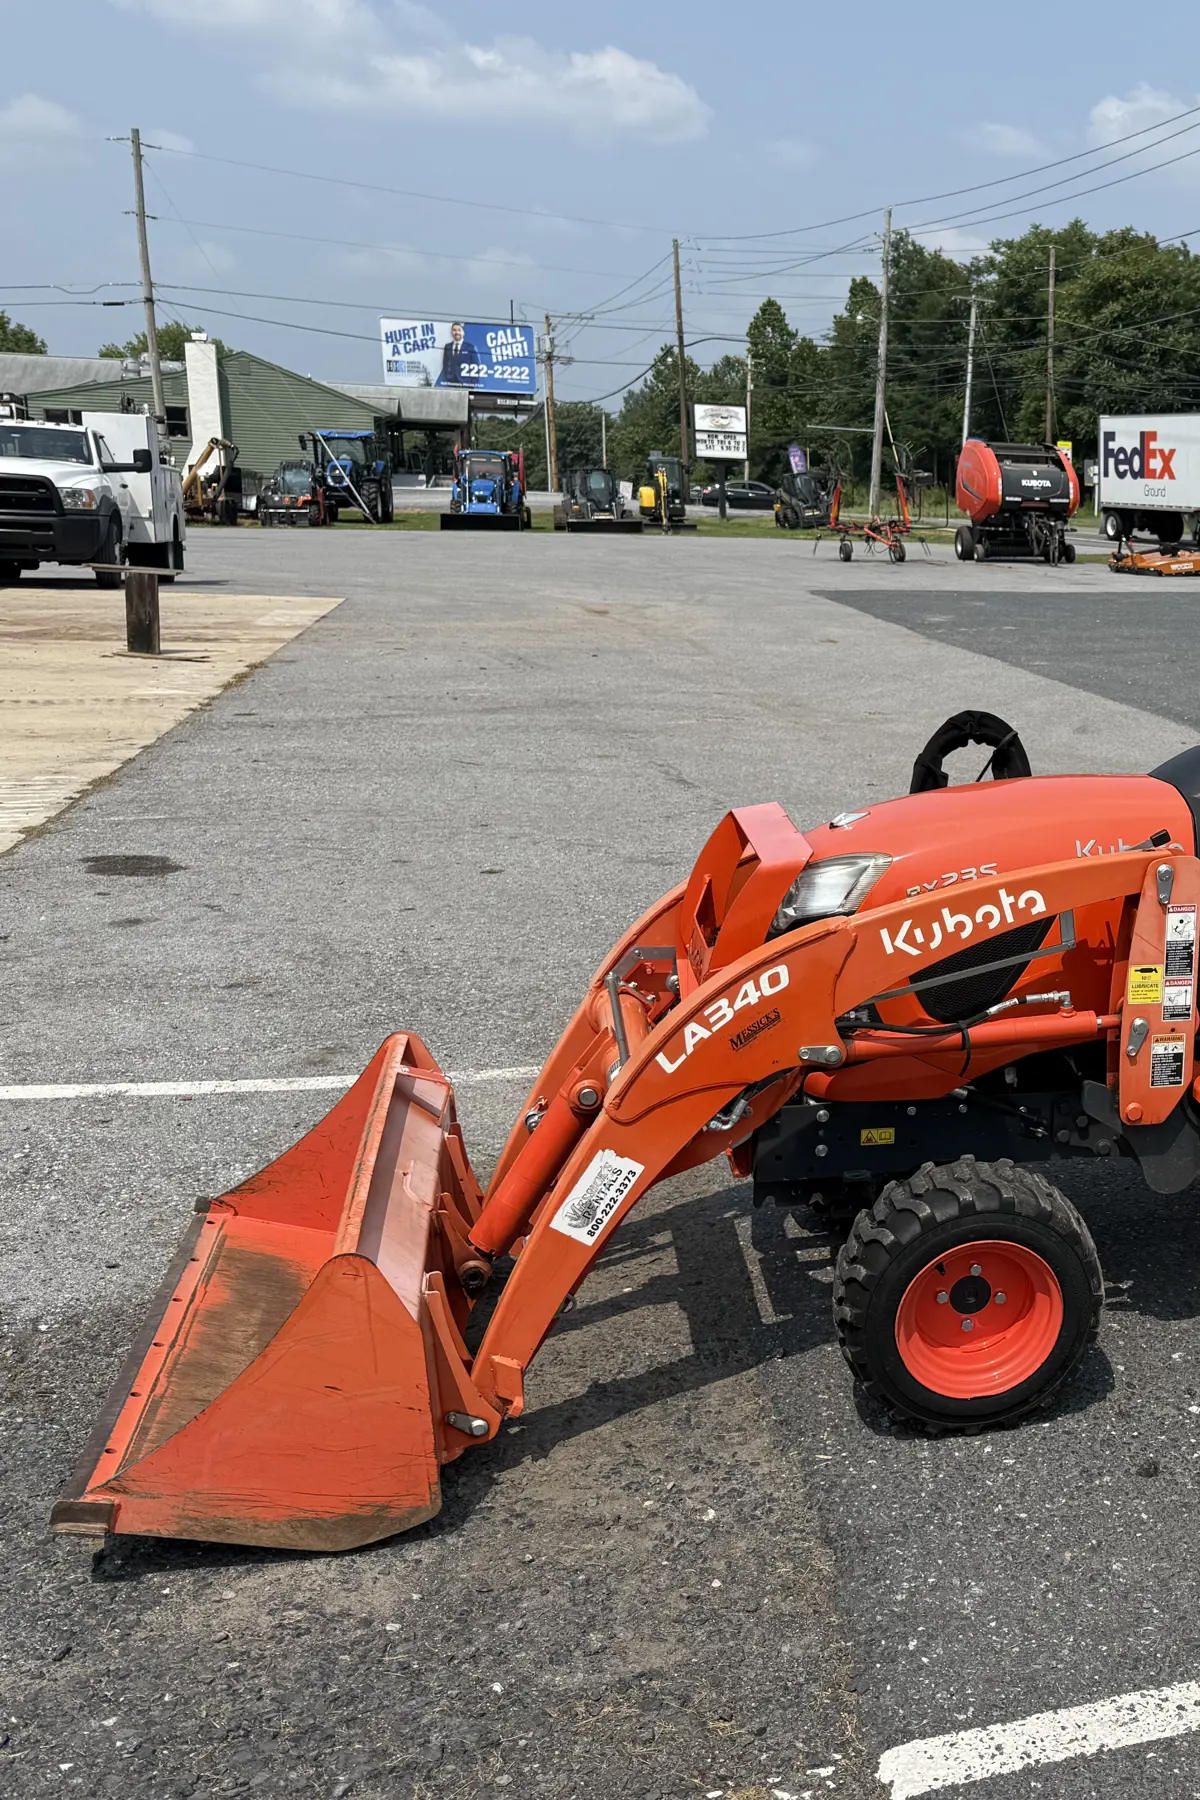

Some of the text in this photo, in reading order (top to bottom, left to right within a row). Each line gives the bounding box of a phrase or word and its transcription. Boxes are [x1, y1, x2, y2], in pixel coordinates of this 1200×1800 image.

[385, 323, 435, 344] HURT IN
[486, 327, 525, 348] CALL
[392, 336, 436, 357] A CAR?
[491, 341, 529, 363] HHR!
[460, 363, 530, 380] 222-2222
[1103, 431, 1176, 480] FedEx
[1021, 479, 1051, 487] KUBOTA
[1143, 484, 1166, 498] Ground
[1075, 838, 1185, 858] Kub
[879, 888, 1047, 956] Kubota
[655, 964, 790, 1074] LA340
[729, 1007, 780, 1051] MESSICK'S
[582, 1167, 623, 1220] RENTALS
[586, 1169, 637, 1237] 800-222-3373
